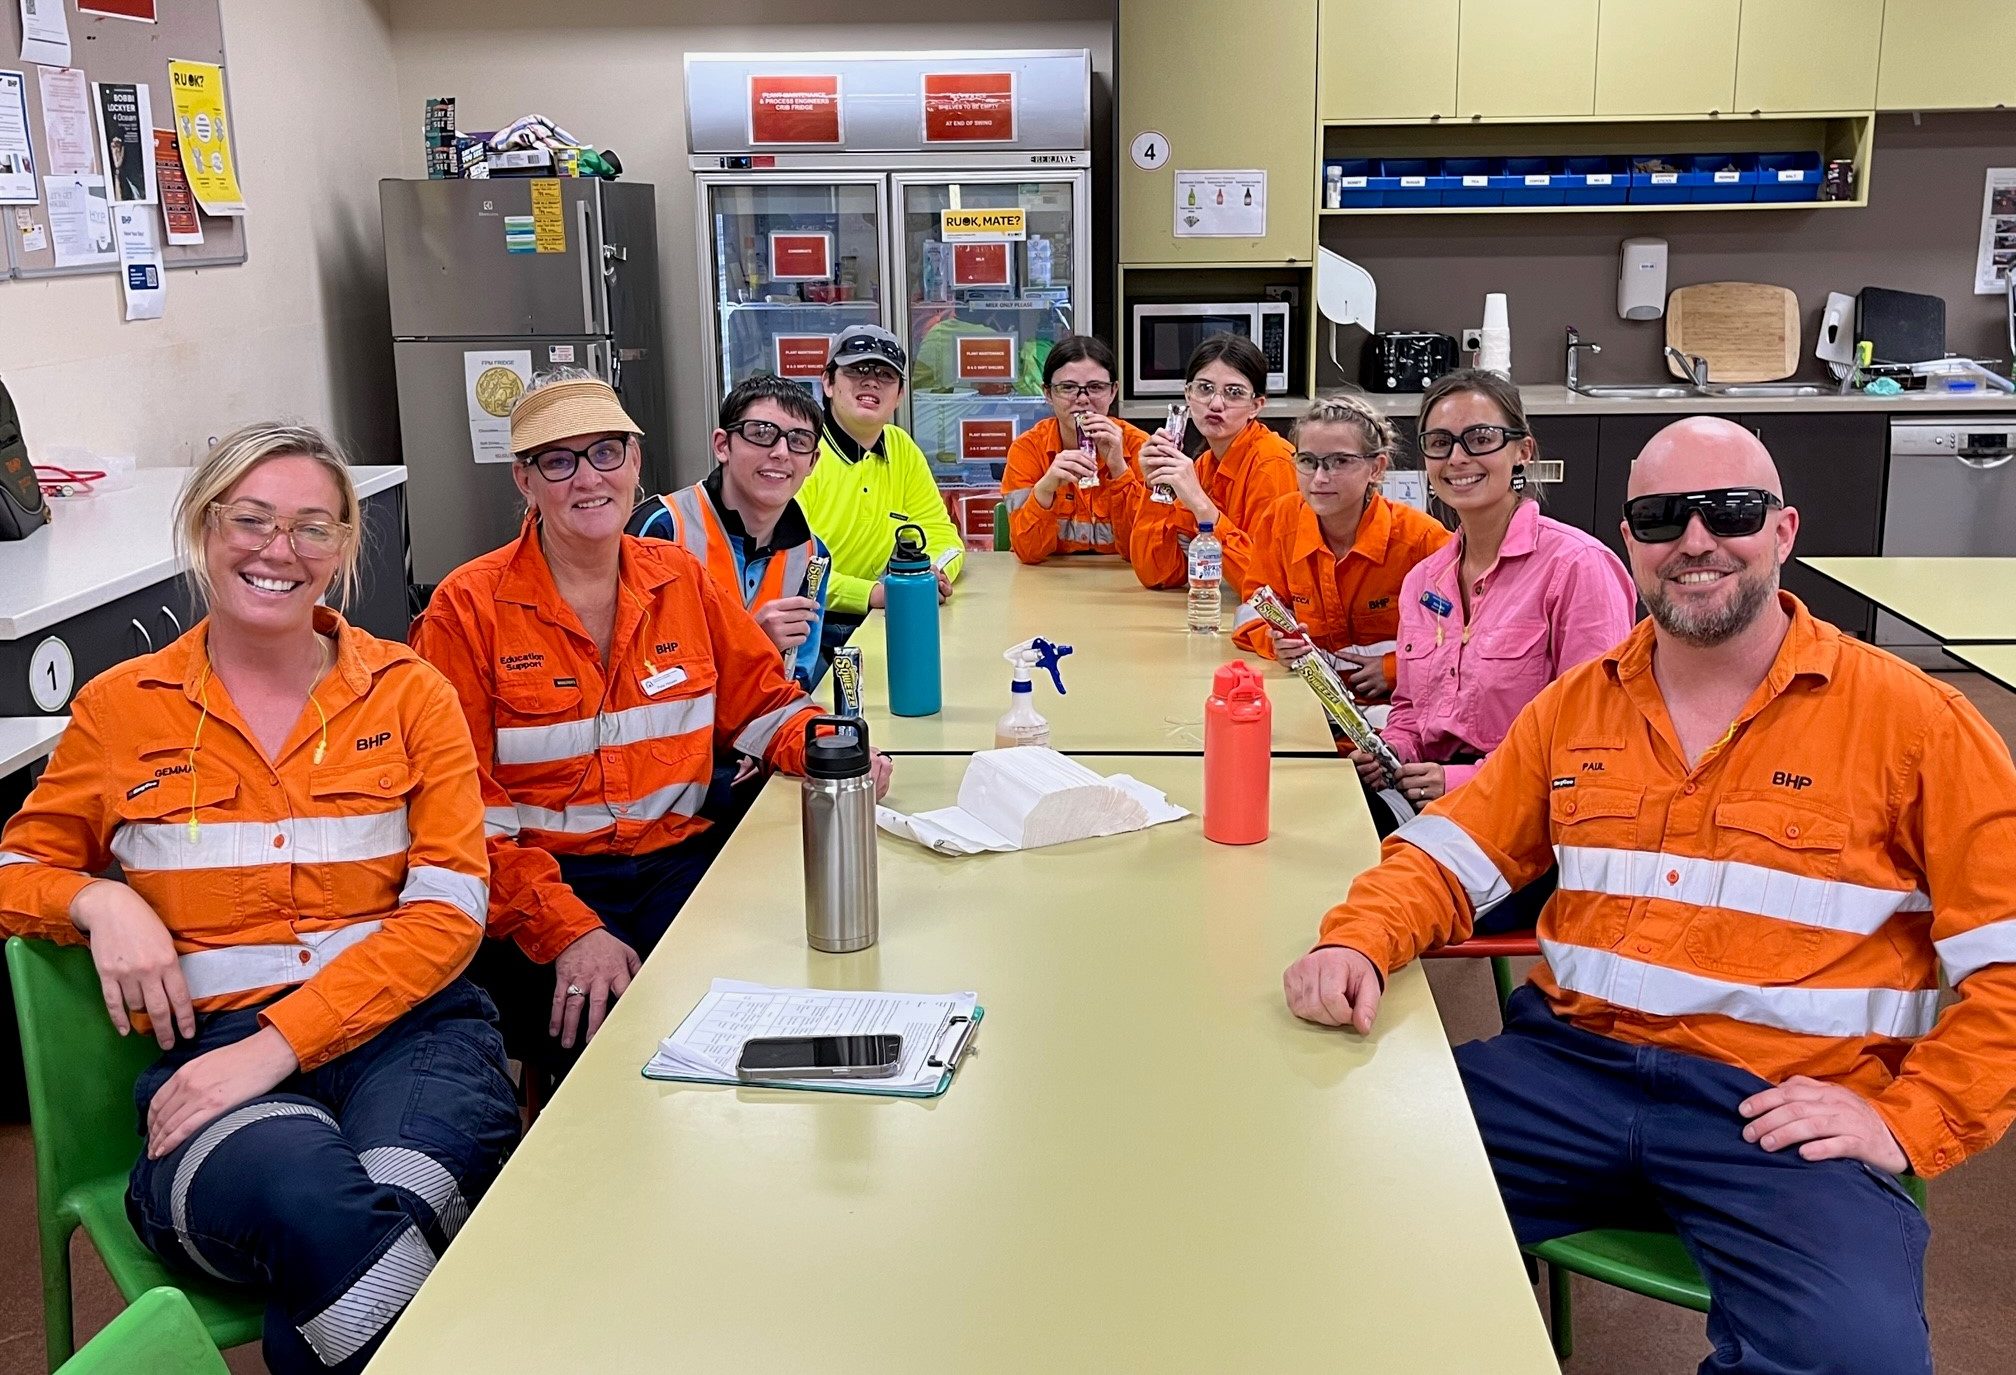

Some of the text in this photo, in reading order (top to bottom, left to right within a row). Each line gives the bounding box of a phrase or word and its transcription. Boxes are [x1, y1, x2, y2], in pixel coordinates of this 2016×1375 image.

[107, 104, 136, 112] LOCKYER
[1144, 143, 1156, 160] 4
[983, 215, 1020, 226] MATE?
[1369, 597, 1389, 609] BHP
[656, 642, 679, 654] BHP
[500, 653, 544, 664] Education
[506, 661, 543, 671] Support
[47, 660, 57, 691] 1
[356, 732, 391, 751] BHP
[155, 764, 197, 777] GEMMA
[1582, 762, 1605, 771] PAUL
[1772, 771, 1813, 791] BHP
